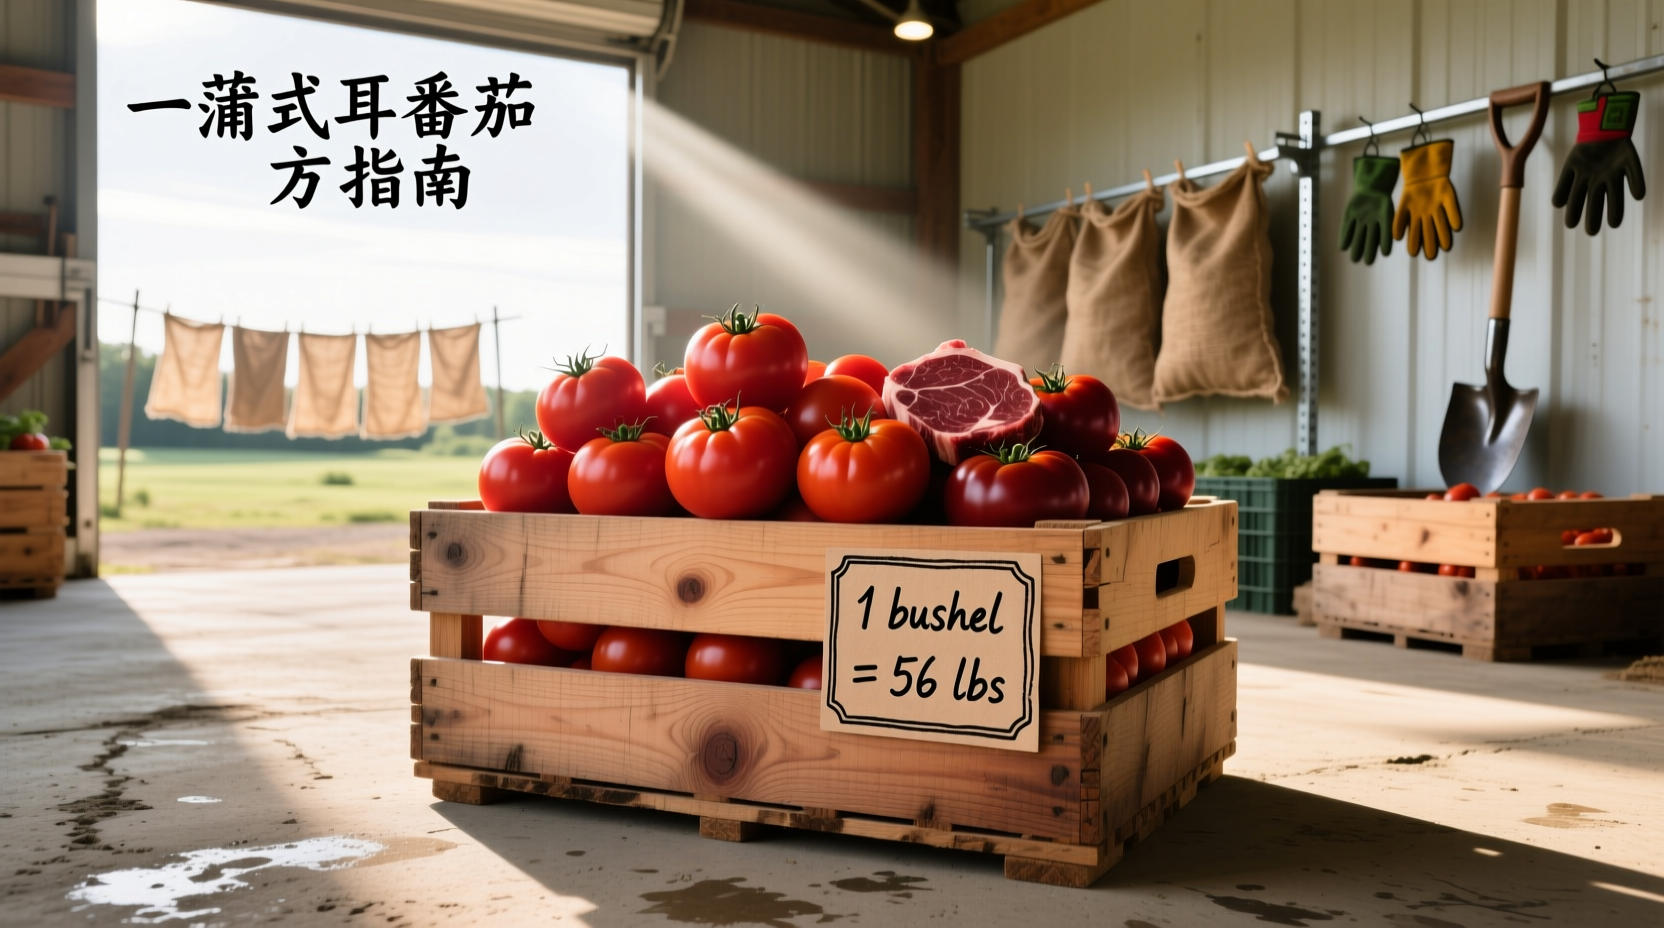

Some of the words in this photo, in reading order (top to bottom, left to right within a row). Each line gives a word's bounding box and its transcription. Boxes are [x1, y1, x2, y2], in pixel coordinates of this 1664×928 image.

[857, 585, 875, 630] 1
[887, 586, 1004, 635] bushel
[852, 664, 878, 684] =
[889, 655, 938, 699] 56
[952, 656, 1006, 704] lbs
